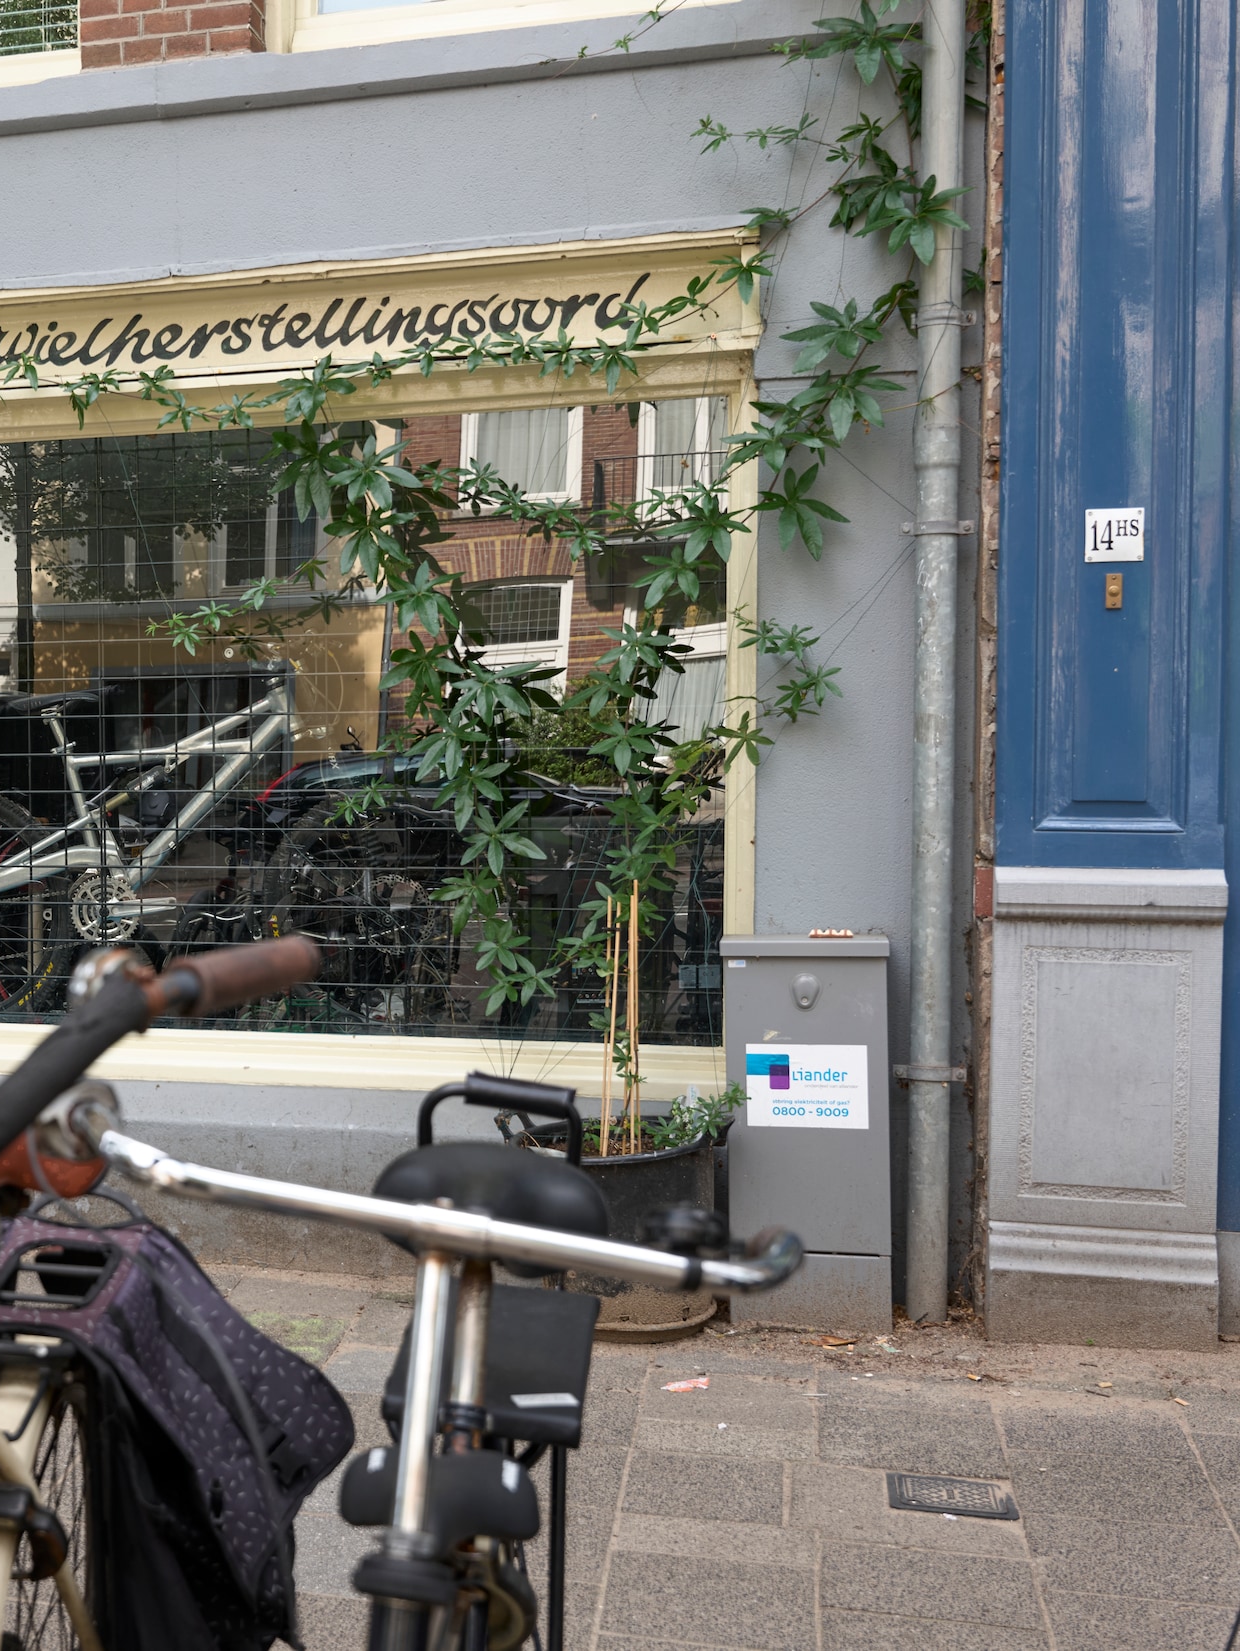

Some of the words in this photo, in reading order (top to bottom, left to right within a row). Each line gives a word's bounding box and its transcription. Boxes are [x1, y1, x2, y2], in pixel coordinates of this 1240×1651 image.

[792, 1068, 848, 1081] Liander
[772, 1106, 806, 1116] 0800
[816, 1107, 850, 1118] 9009
